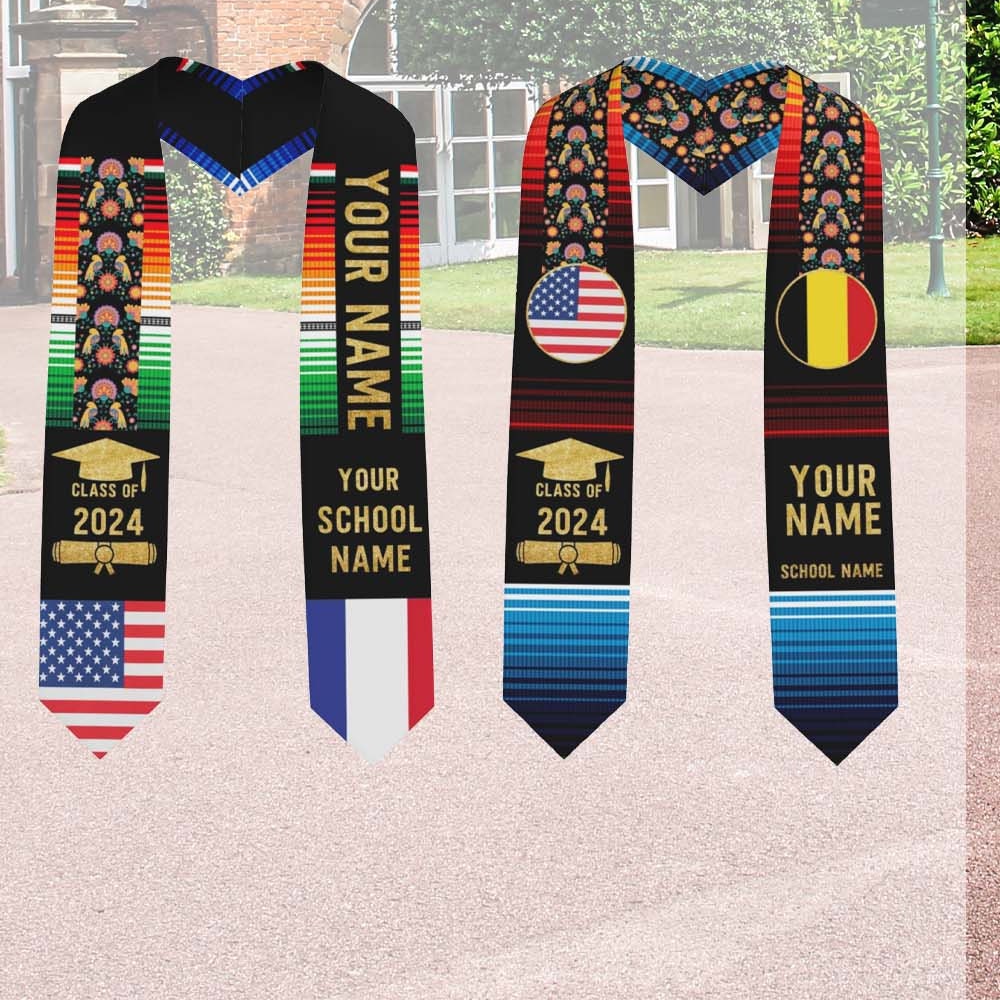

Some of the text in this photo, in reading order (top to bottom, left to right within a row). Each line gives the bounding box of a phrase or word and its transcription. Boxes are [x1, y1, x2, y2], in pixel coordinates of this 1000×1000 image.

[344, 168, 392, 431] YOUR NAME
[71, 482, 139, 499] CLASS OF
[337, 467, 399, 492] YOUR
[535, 482, 603, 499] CLASS OF
[789, 463, 876, 498] YOUR
[73, 506, 145, 536] 2024
[317, 504, 423, 534] SCHOOL
[537, 506, 609, 536] 2024
[785, 501, 882, 537] NAME
[331, 544, 412, 573] NAME
[780, 562, 884, 580] SCHOOL NAME
